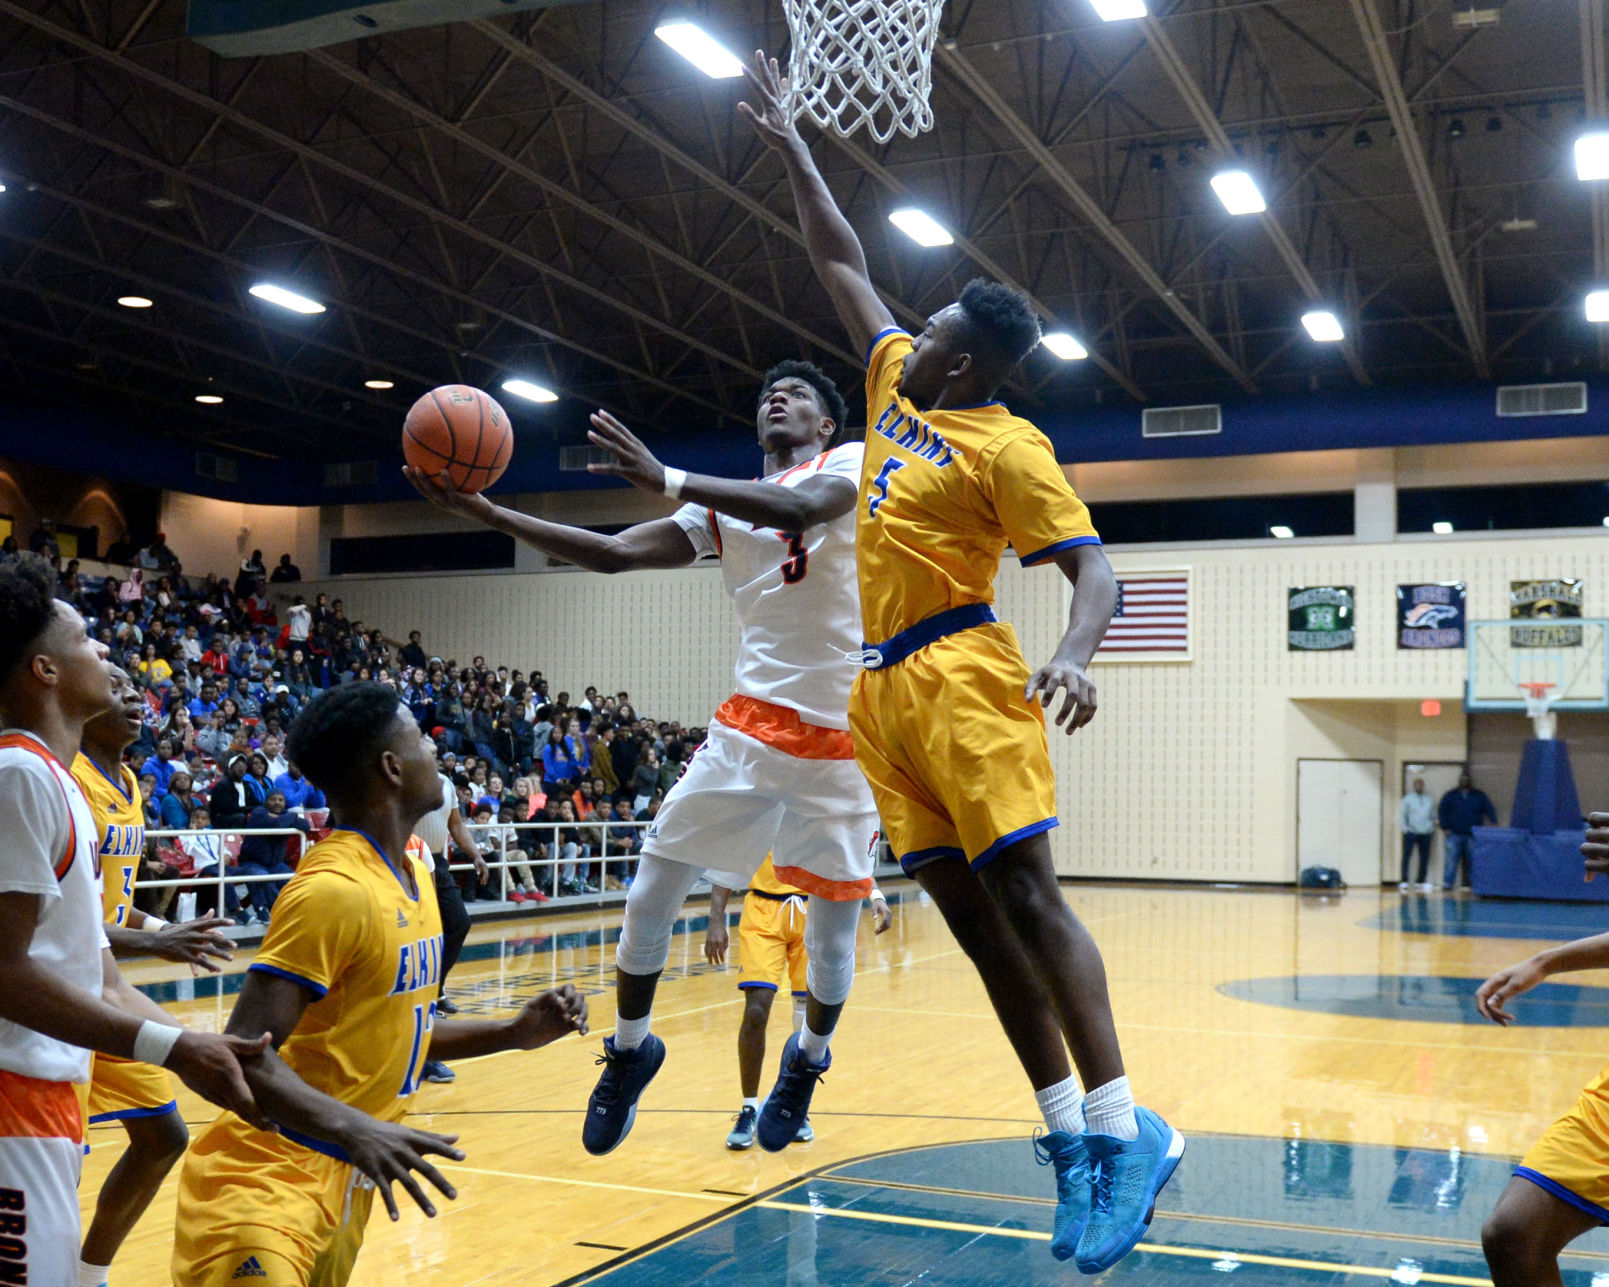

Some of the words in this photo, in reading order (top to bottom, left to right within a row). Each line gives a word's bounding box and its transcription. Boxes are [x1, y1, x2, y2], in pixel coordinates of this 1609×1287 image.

[868, 455, 908, 519] 5
[775, 530, 809, 585] 3
[0, 1187, 28, 1287] BRON
